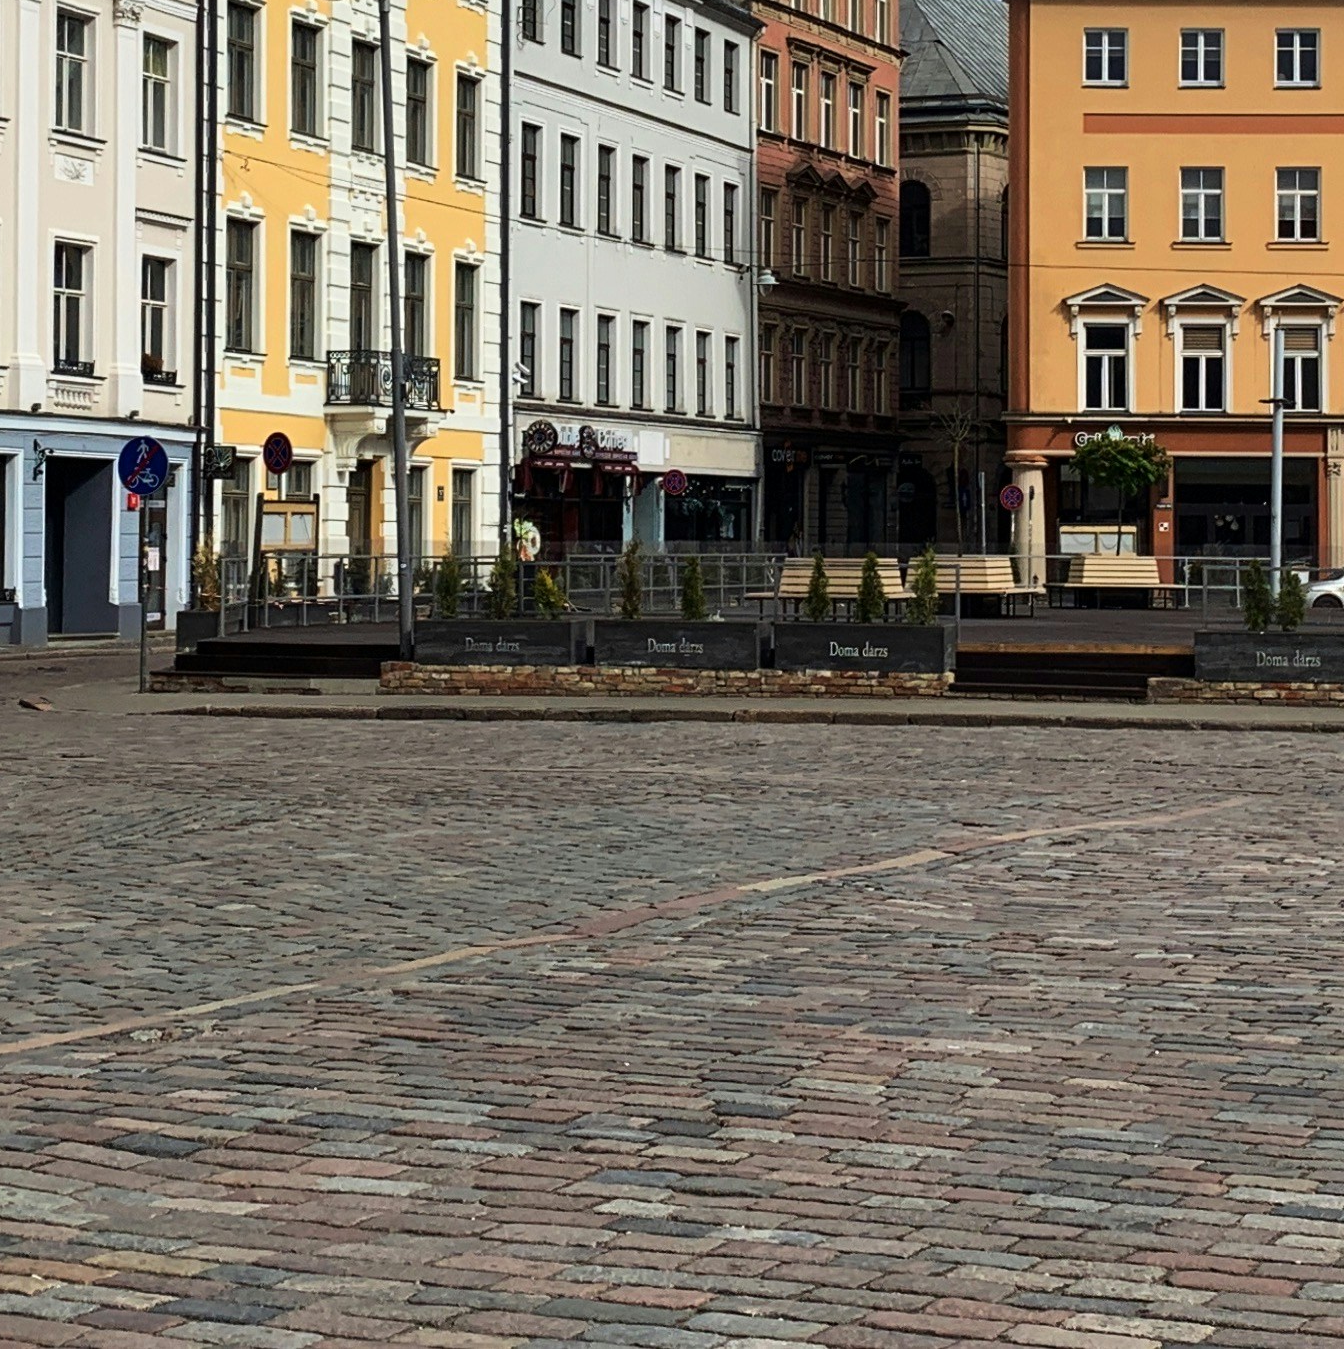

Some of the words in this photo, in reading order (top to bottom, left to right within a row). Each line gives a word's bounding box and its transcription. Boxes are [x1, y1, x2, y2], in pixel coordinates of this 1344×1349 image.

[648, 638, 675, 652] Doma
[829, 641, 859, 656] Doma
[1256, 651, 1288, 666] Doma
